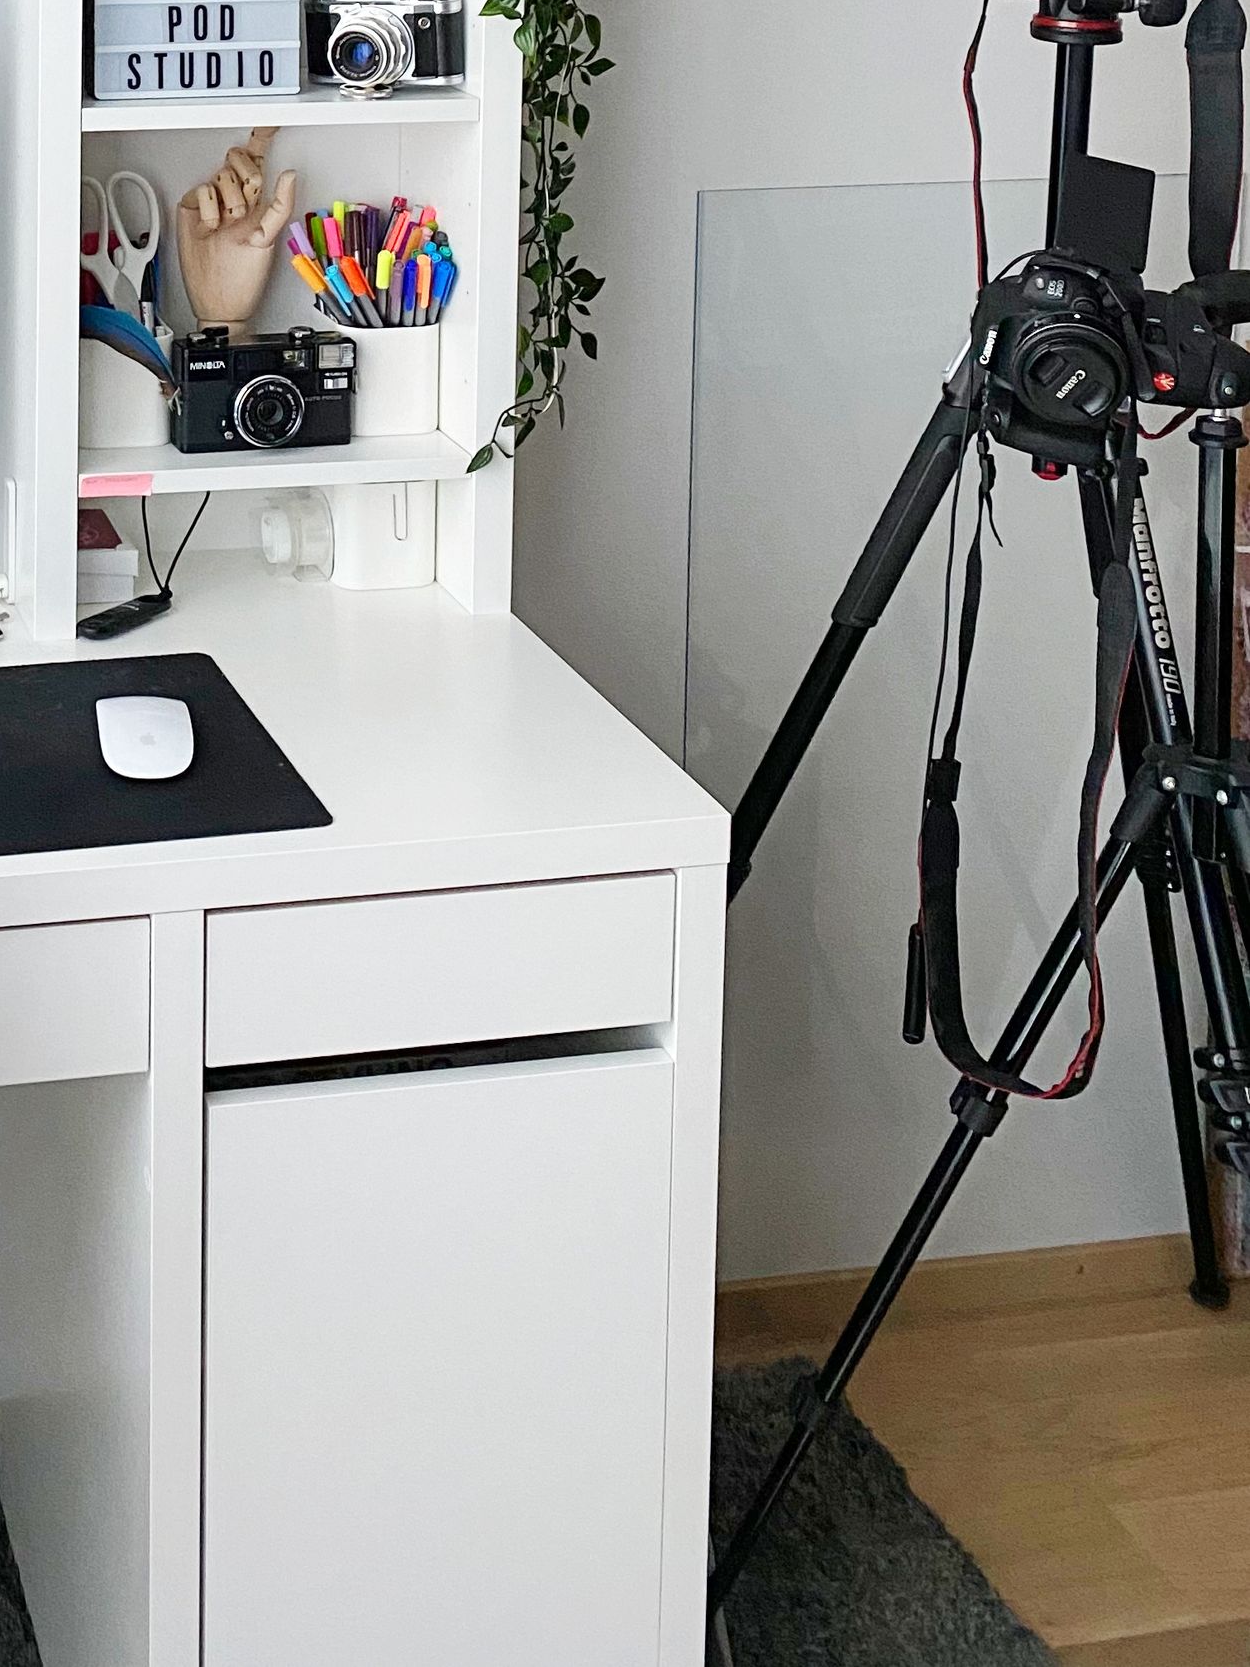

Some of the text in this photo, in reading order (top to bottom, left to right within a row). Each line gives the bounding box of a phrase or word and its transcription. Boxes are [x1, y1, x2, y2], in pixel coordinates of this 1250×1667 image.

[168, 4, 235, 43] POD
[127, 50, 274, 90] STUDIO
[190, 360, 226, 371] MINOLTA
[979, 329, 998, 365] Canon
[1055, 369, 1086, 400] Canon
[1132, 498, 1182, 694] Manfrotto 190
